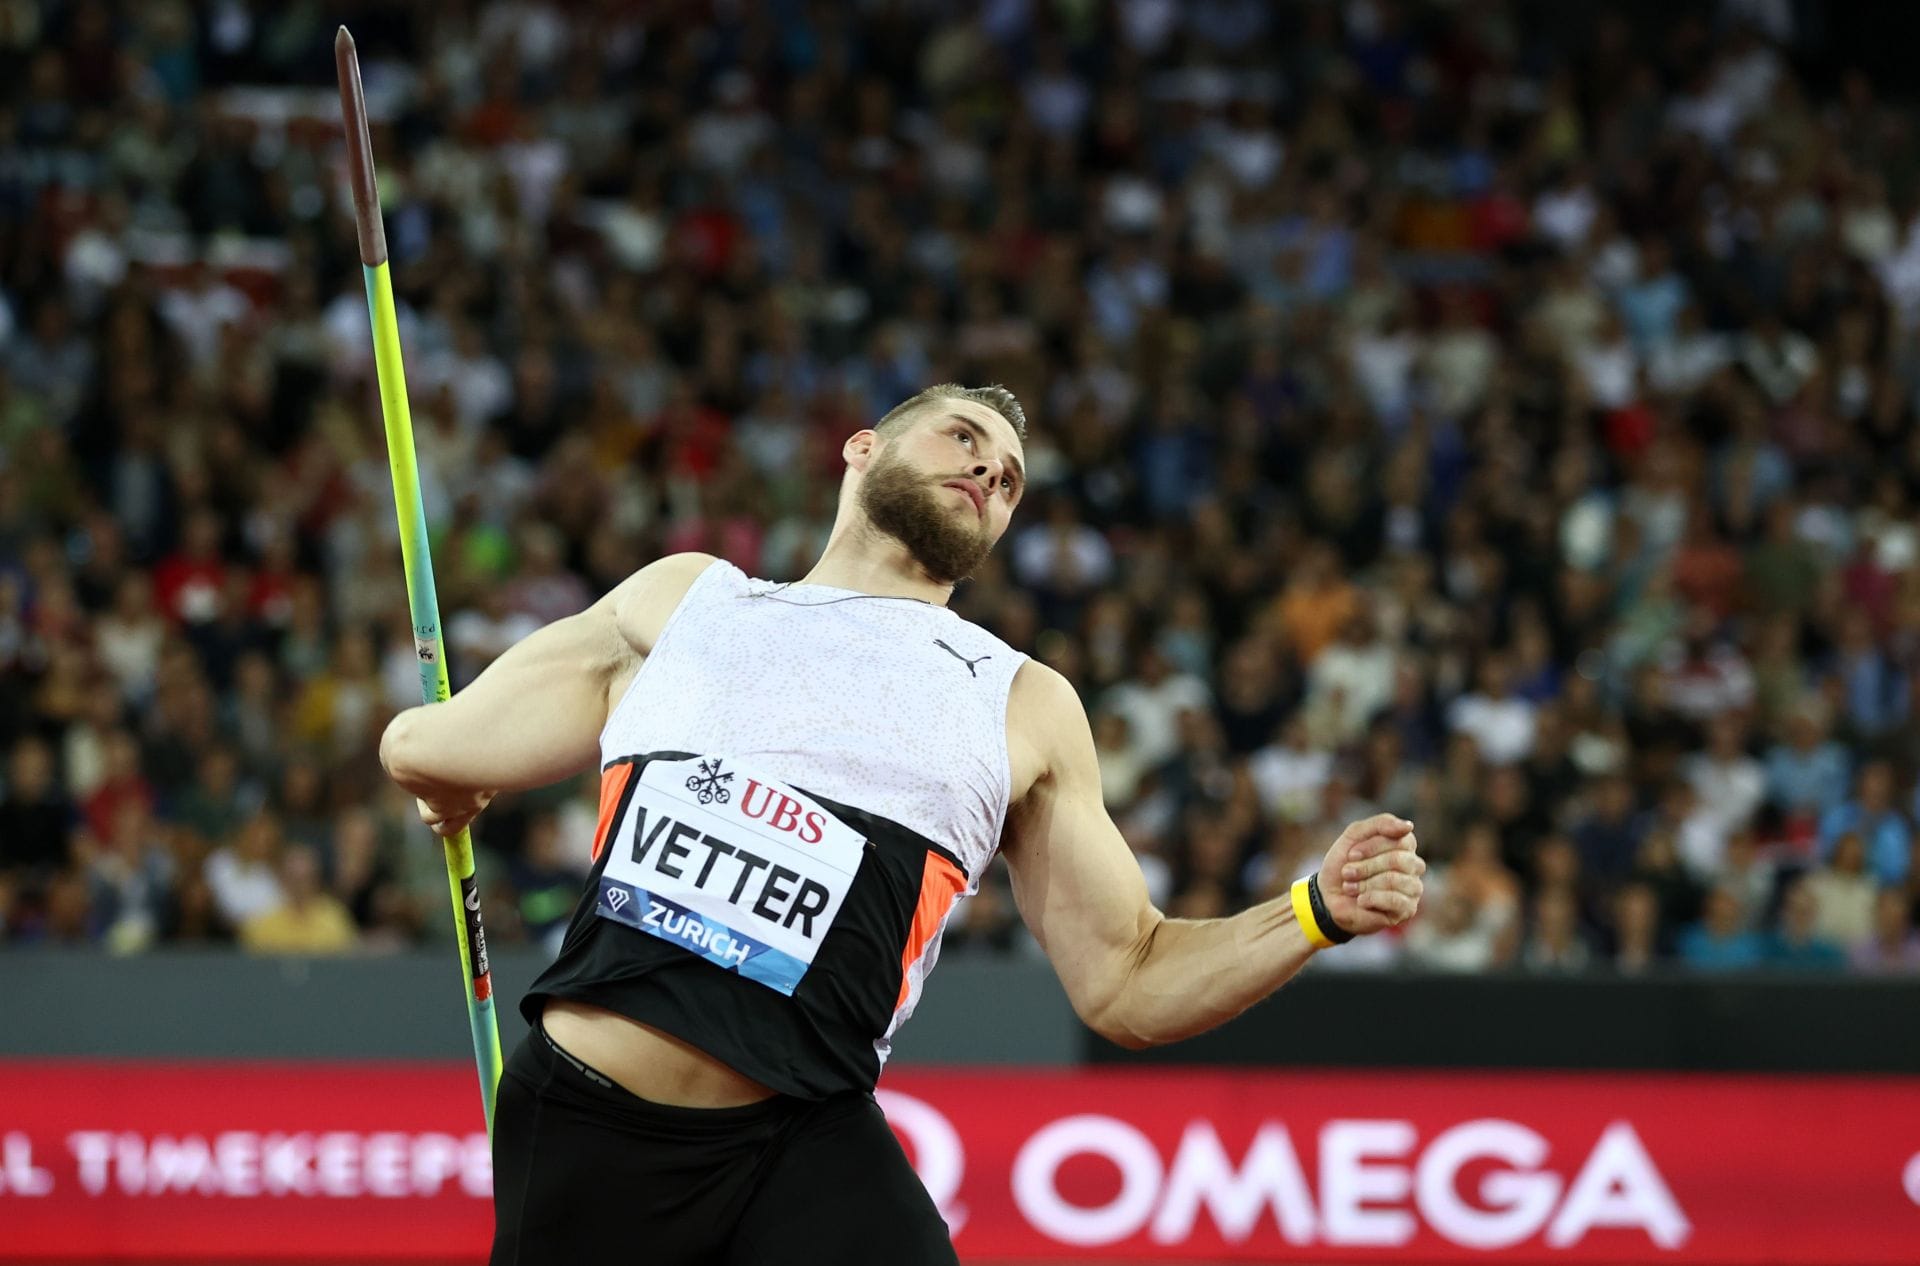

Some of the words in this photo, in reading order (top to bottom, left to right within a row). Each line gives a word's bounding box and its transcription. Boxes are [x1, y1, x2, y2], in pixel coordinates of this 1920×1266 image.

[740, 778, 827, 844] UBS
[630, 805, 830, 939] VETTER
[641, 900, 750, 966] ZURICH
[1011, 1114, 1690, 1250] OMEGA
